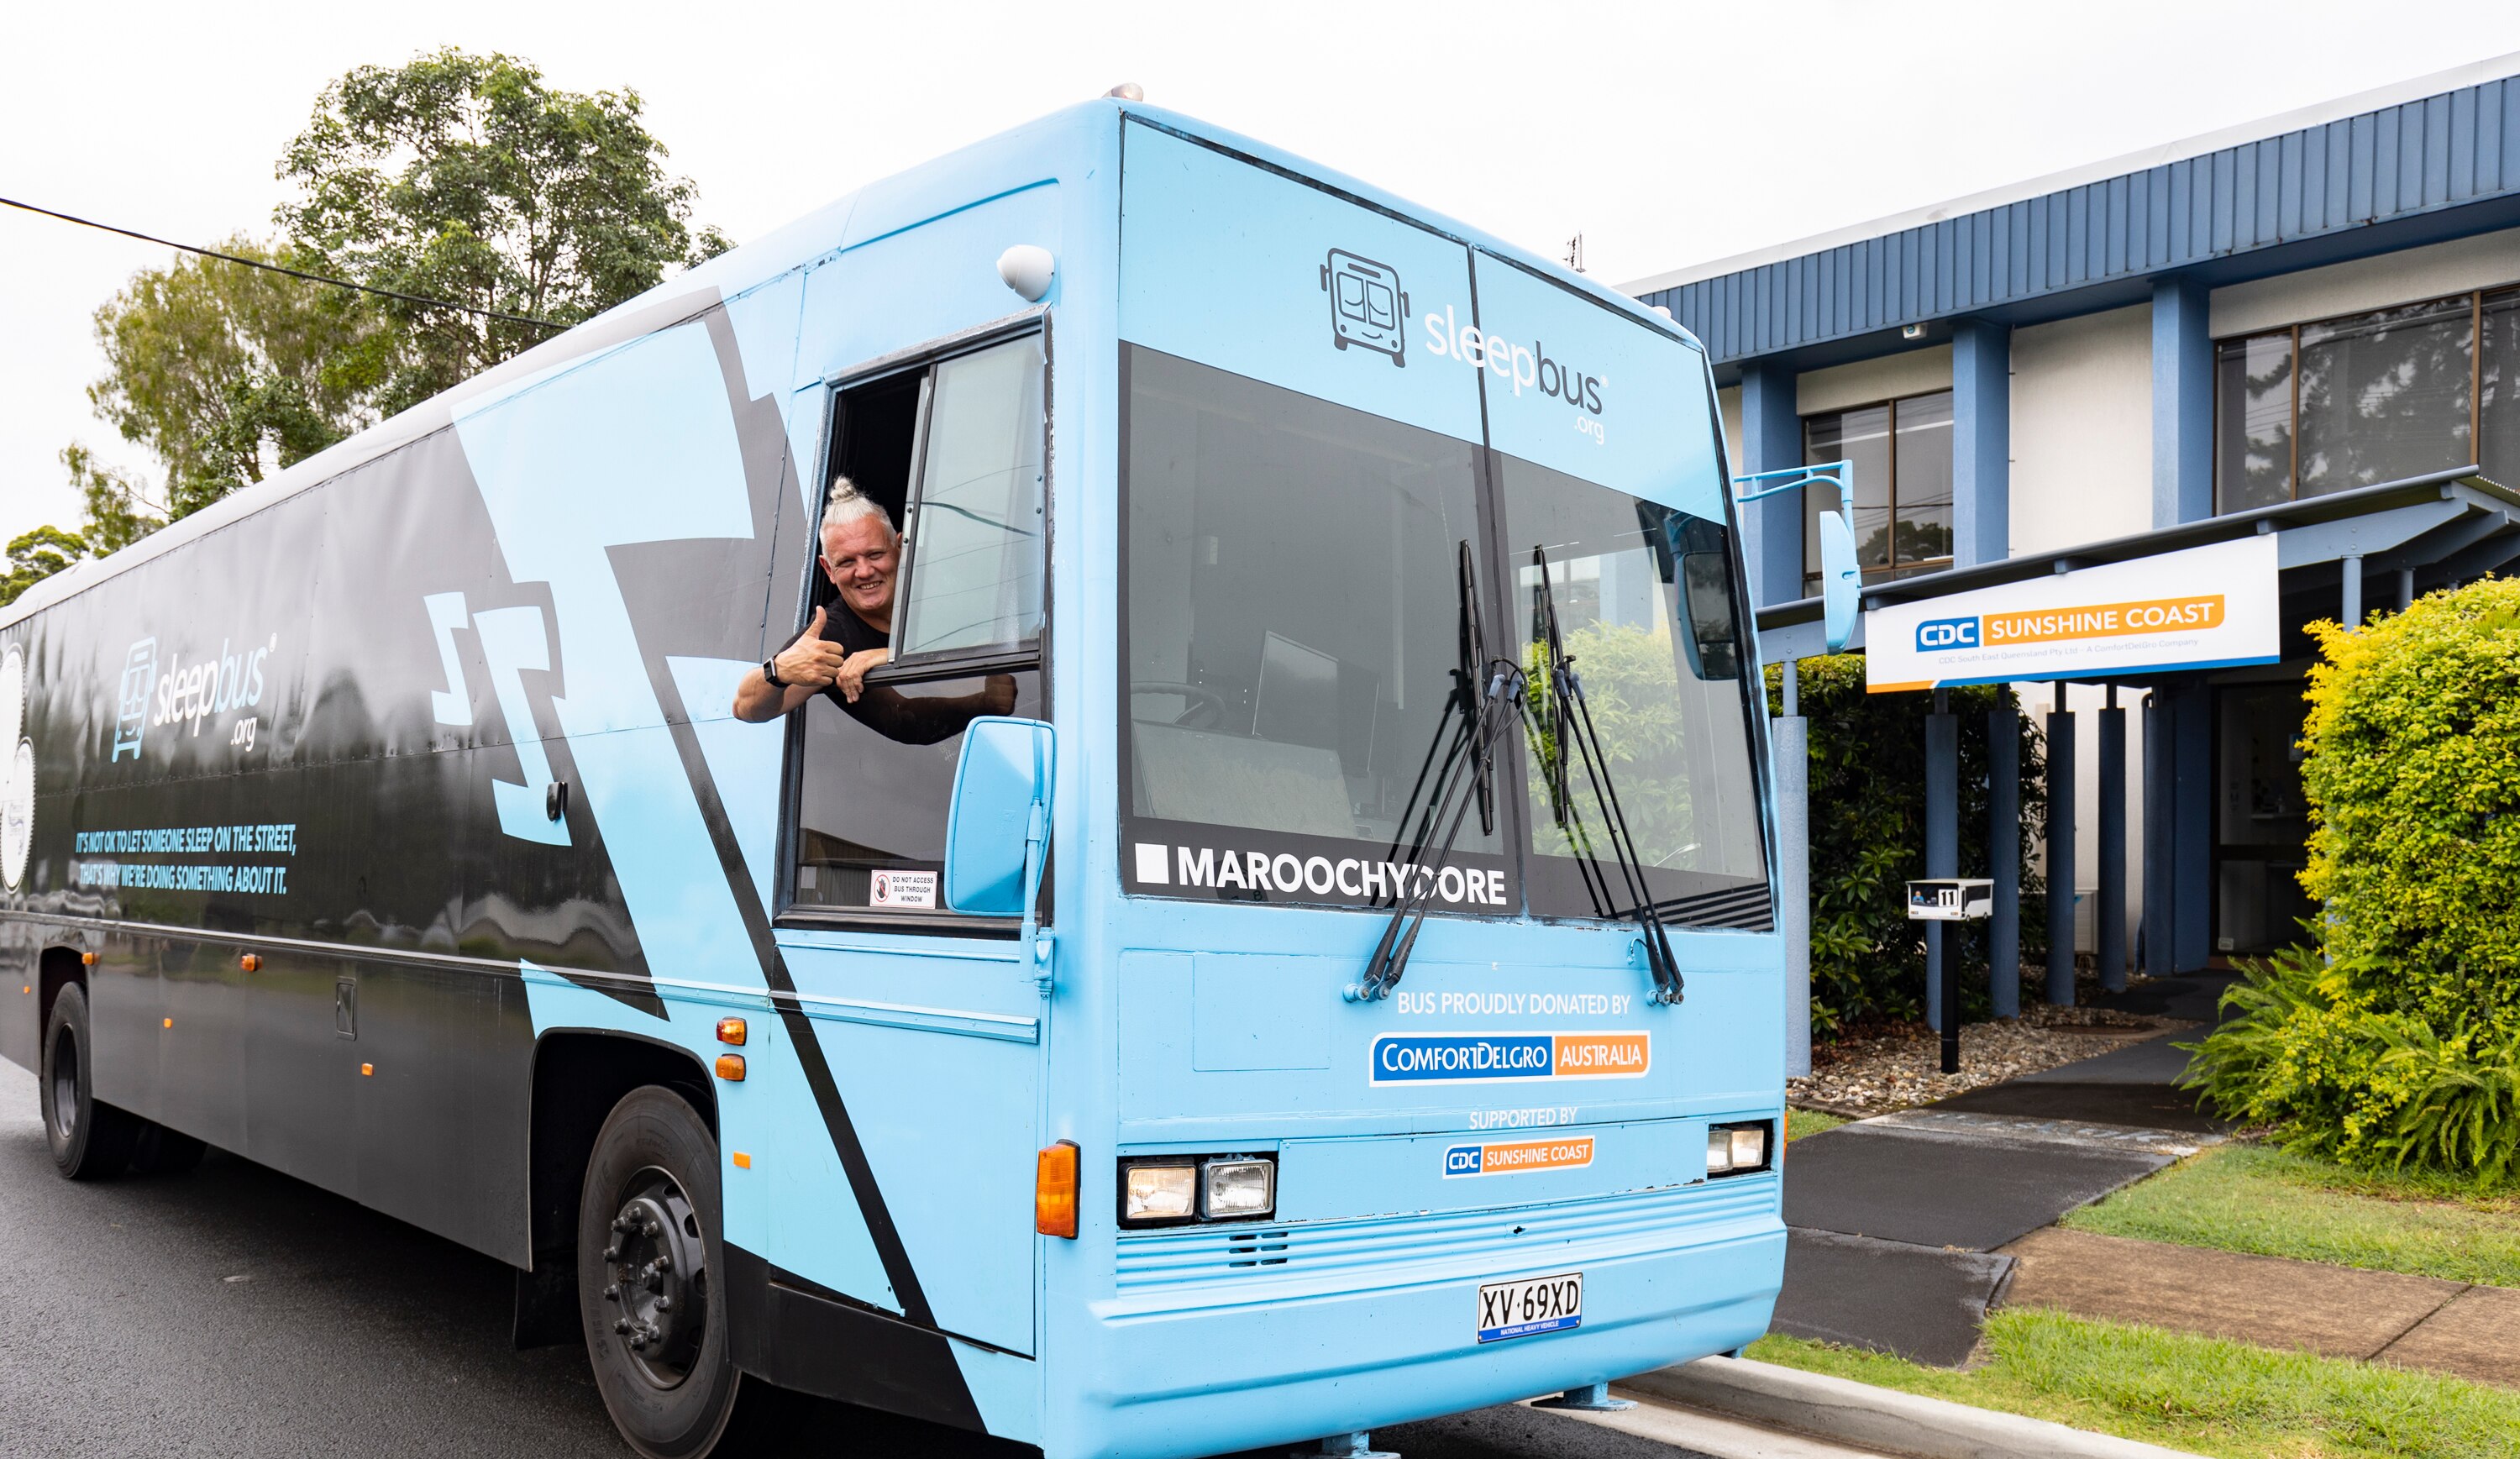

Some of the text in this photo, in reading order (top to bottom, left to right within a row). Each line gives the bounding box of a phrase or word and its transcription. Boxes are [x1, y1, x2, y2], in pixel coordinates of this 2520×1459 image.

[1574, 416, 1604, 445] .org
[1919, 602, 2214, 646] CDC SUNSHINE COAST
[2001, 648, 2048, 659] Queensland
[2050, 648, 2063, 658] Pty
[2094, 641, 2157, 653] ComfortDelGro
[2159, 638, 2198, 649] Company
[231, 716, 257, 752] .org
[76, 824, 297, 856] IT'S NOT OK TO LET SOMEONE SLEEP ON THE STREET,
[80, 863, 287, 895] THAT'S WHY WE'RE DOING SOMETHING ABOUT IT.
[1177, 846, 1507, 905] MAROOCHYDORE
[1941, 890, 1954, 905] 11
[1398, 992, 1631, 1015] BUS PROUDLY DONATED BY
[1560, 1044, 1643, 1068] AUSTRALIA
[1469, 1106, 1578, 1130] SUPPORTED BY
[1448, 1144, 1589, 1170] CDC SUNSHINE COAST
[1500, 1320, 1559, 1336] NATIONAL HEAVY VEHICLE
